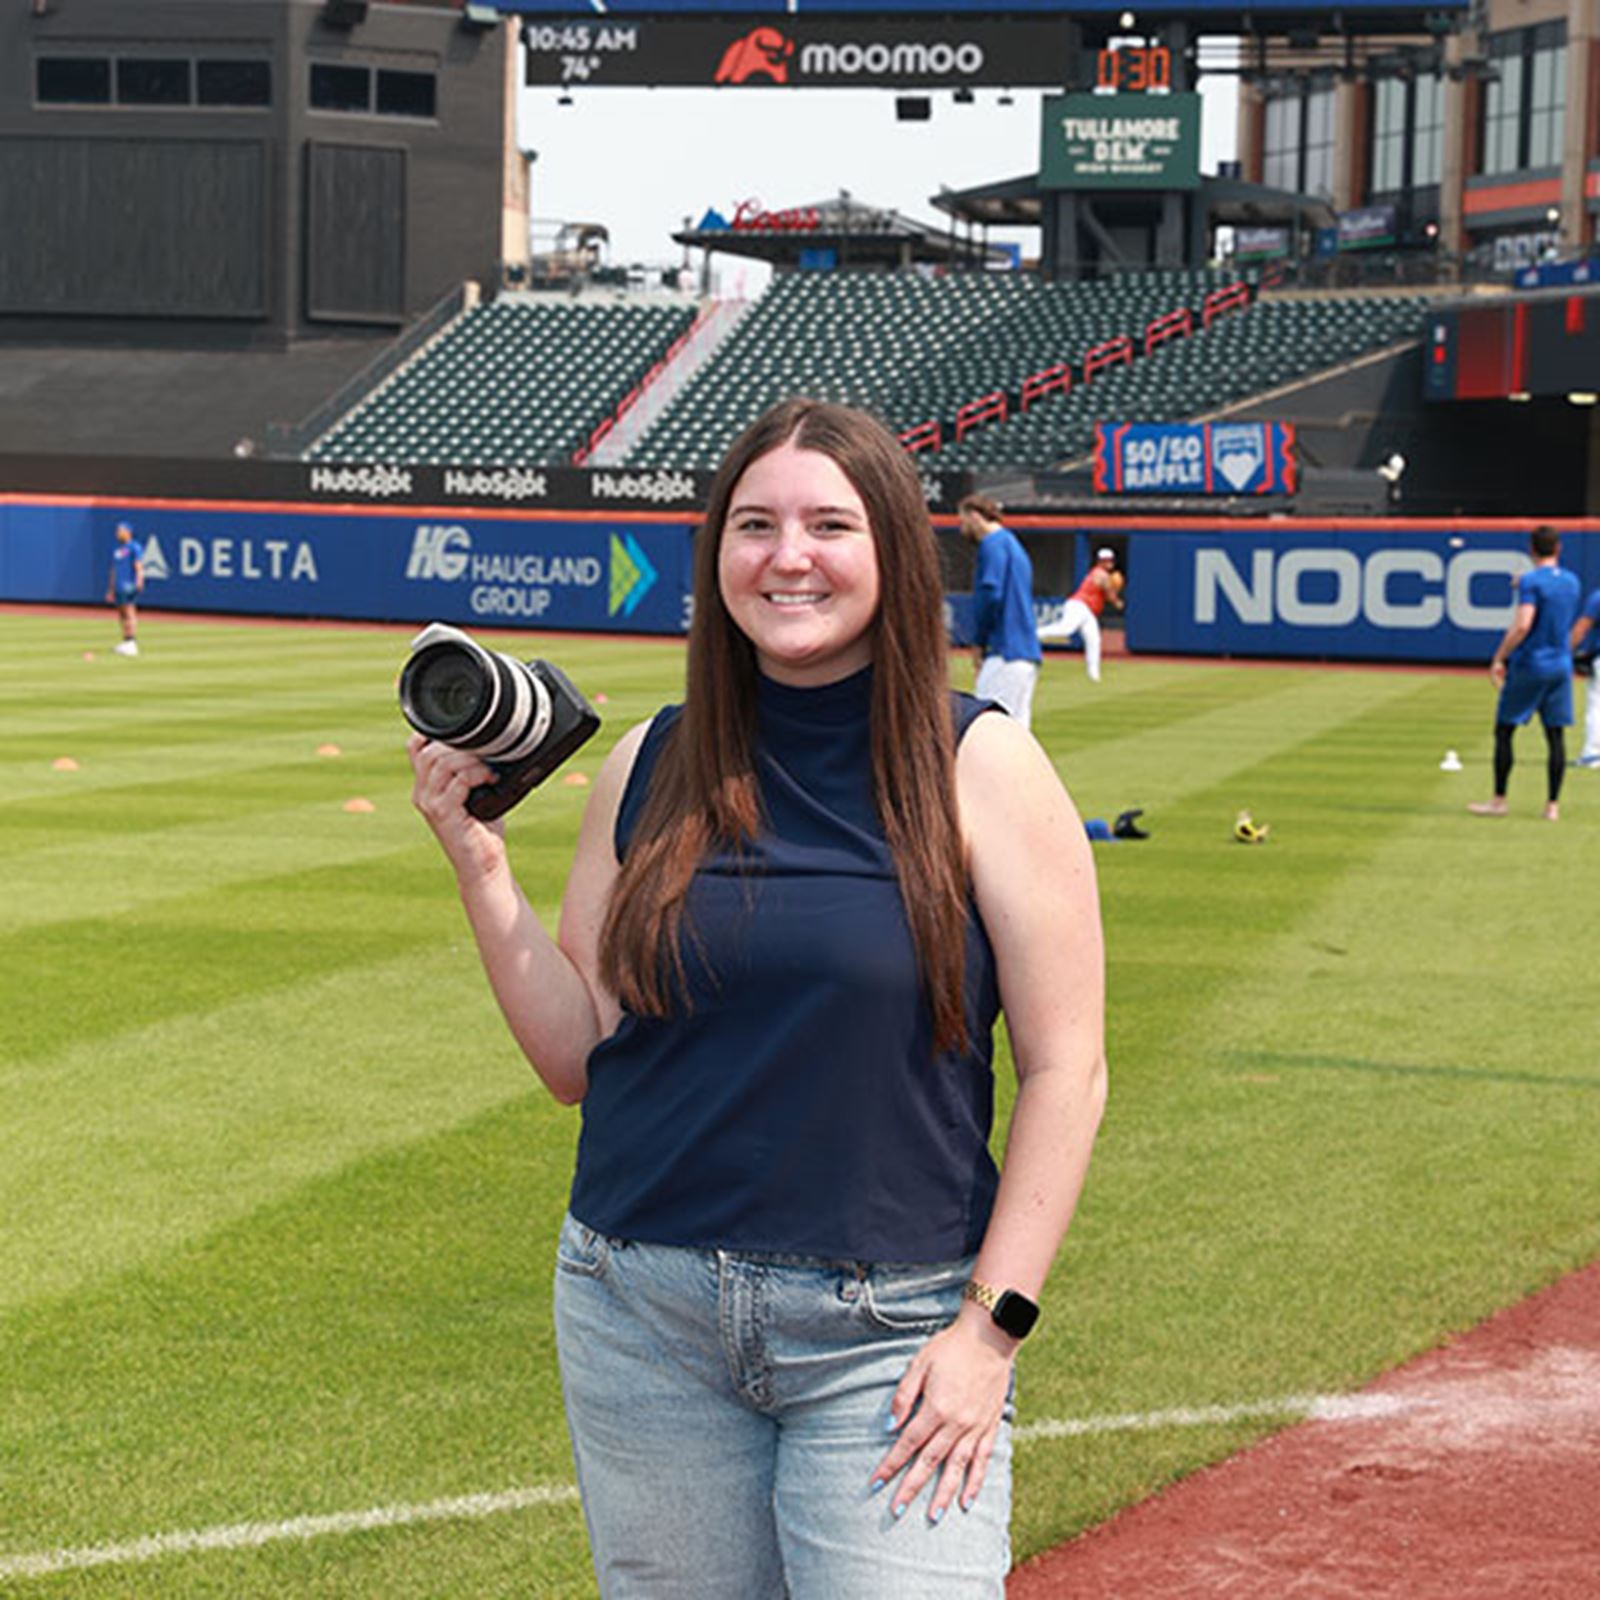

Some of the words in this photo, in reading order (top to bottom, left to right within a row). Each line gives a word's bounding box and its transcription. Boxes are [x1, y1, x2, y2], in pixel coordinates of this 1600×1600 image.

[594, 28, 636, 51] AM
[801, 42, 983, 74] moomoo
[1062, 118, 1180, 141] TULLAMORE
[310, 464, 412, 497] HubSpot
[444, 468, 547, 500] HubSpot
[591, 471, 695, 503] HubSpot
[1124, 462, 1202, 488] RAFFLE
[179, 537, 318, 581] DELTA
[406, 526, 471, 581] HG
[471, 555, 601, 587] HAUGLAND
[470, 585, 551, 617] GROUP
[1194, 549, 1535, 630] NOCO
